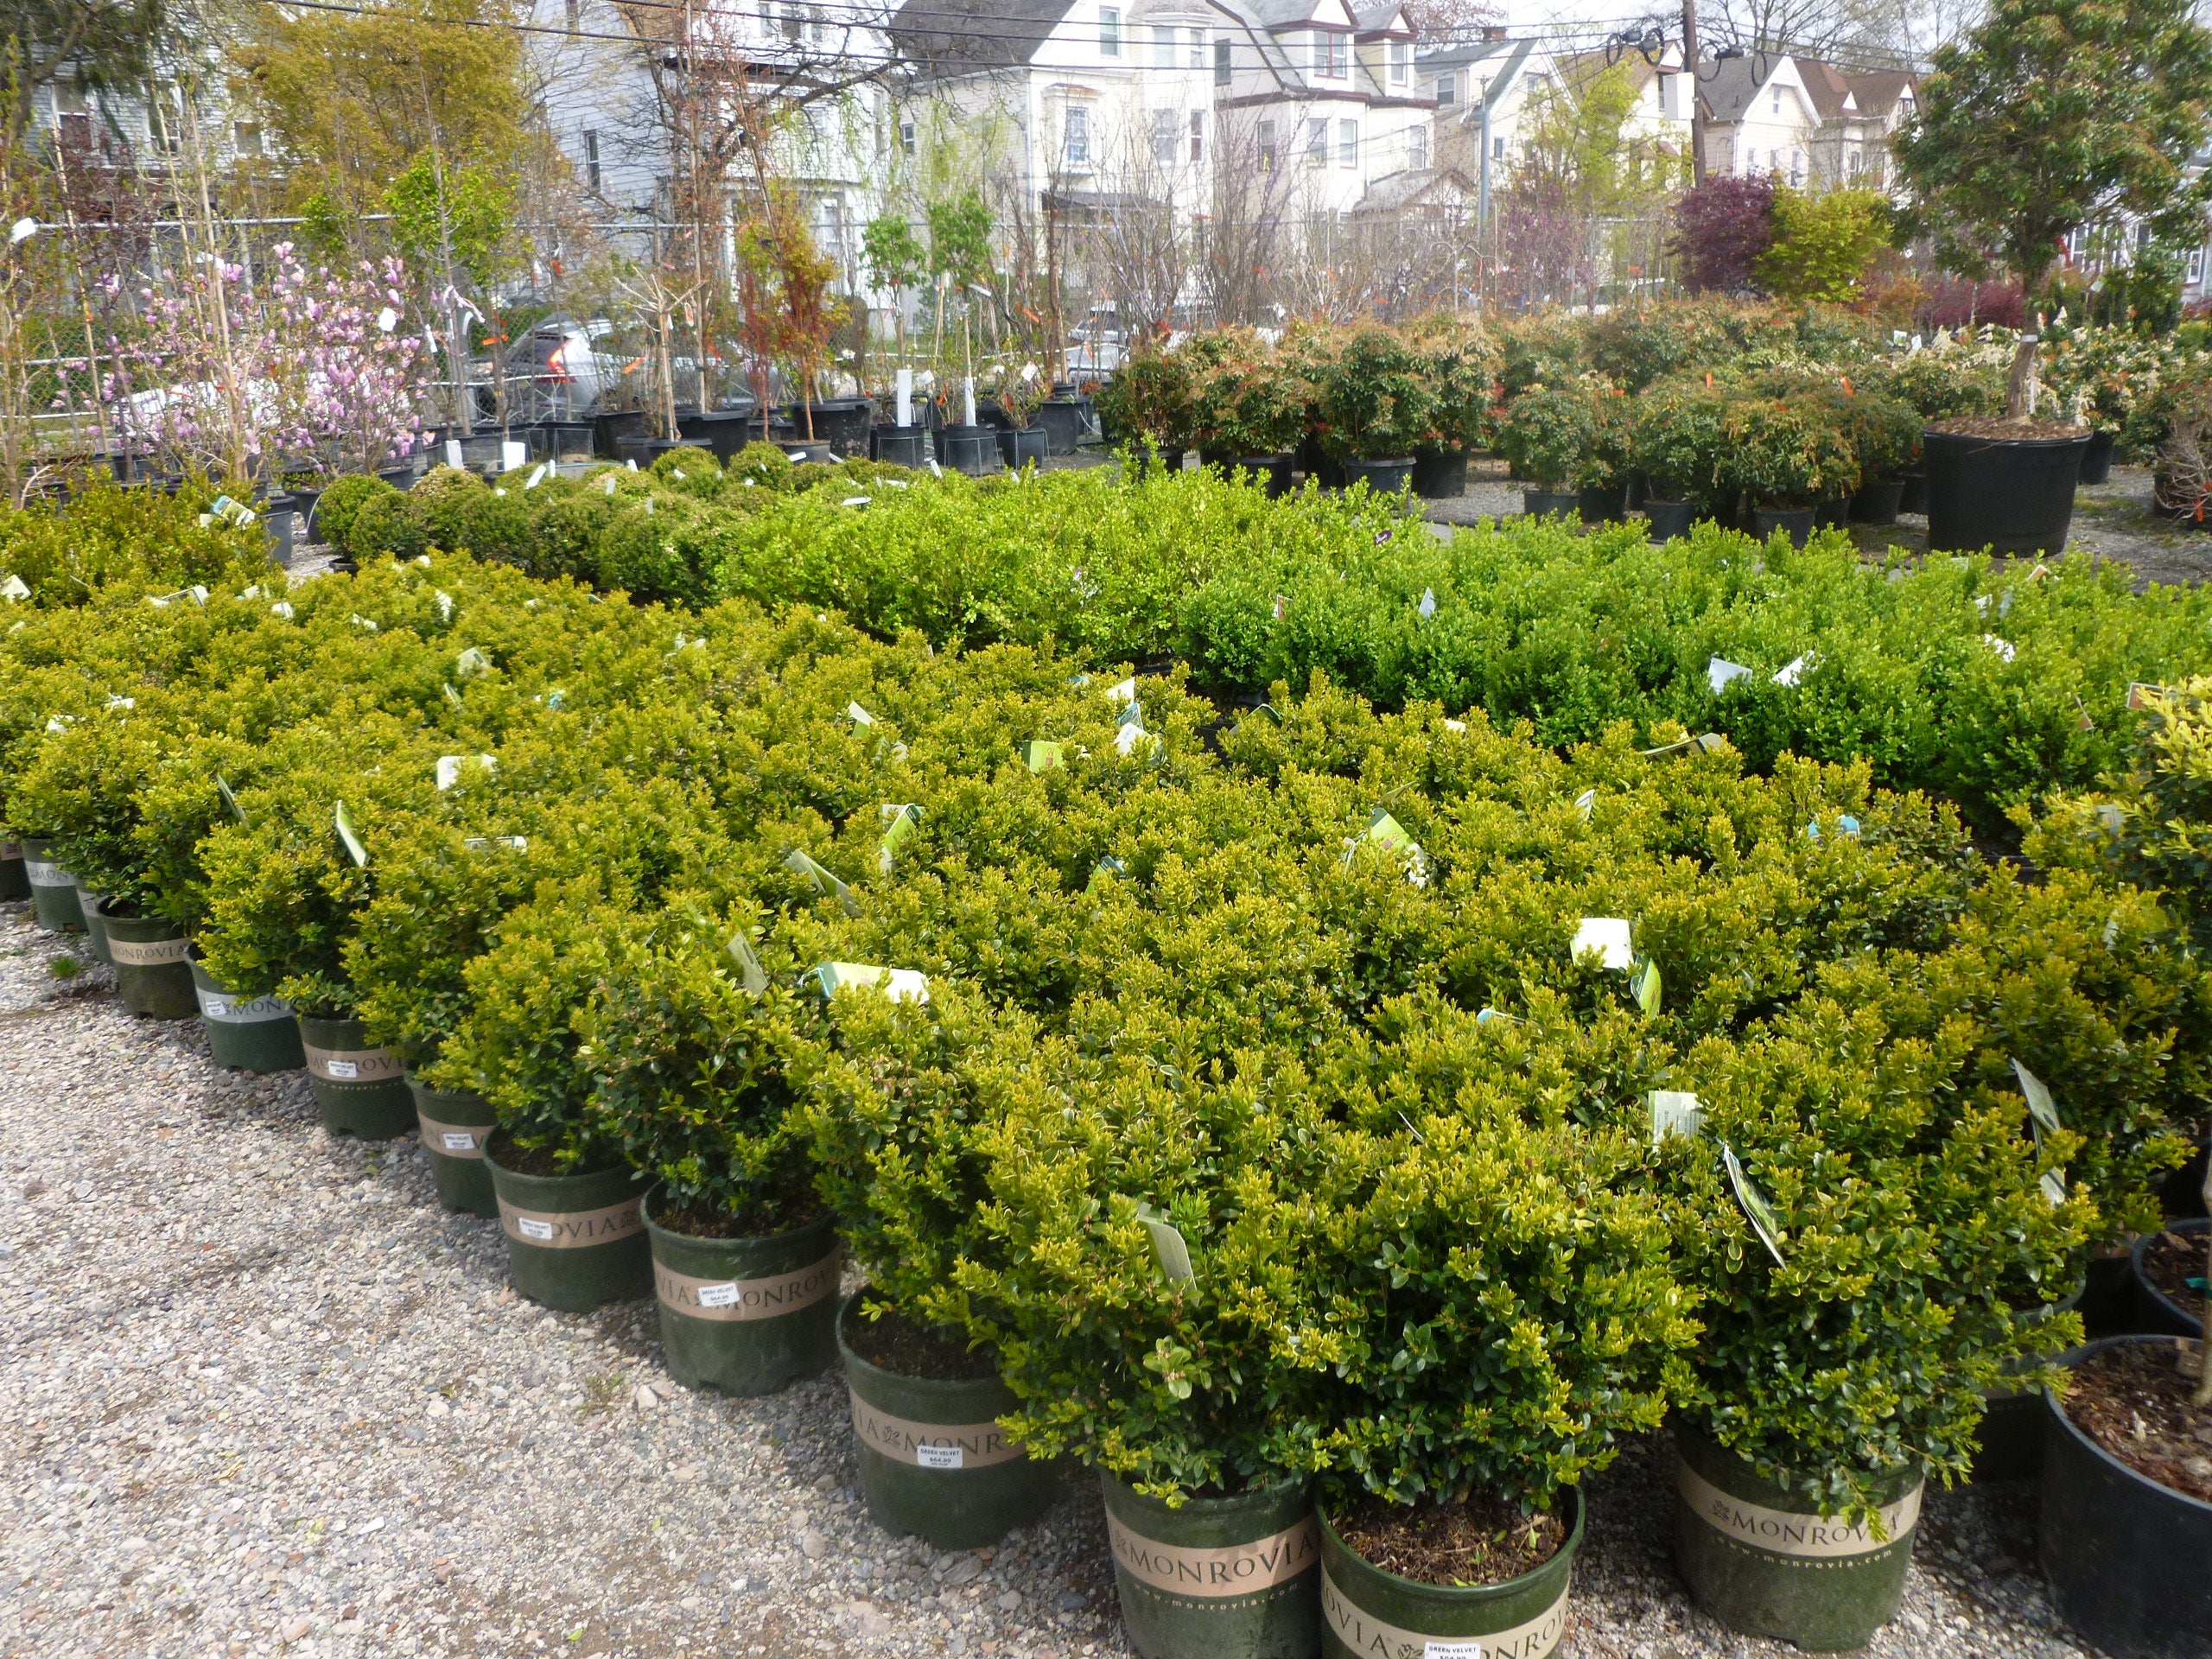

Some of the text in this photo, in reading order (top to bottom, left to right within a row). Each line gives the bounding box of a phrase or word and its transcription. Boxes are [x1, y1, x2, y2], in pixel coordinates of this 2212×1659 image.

[1130, 1533, 1313, 1584] MONROVIA
[1718, 1536, 1891, 1568] www.monrovia.com
[1135, 1582, 1298, 1611] www.monrovia.com
